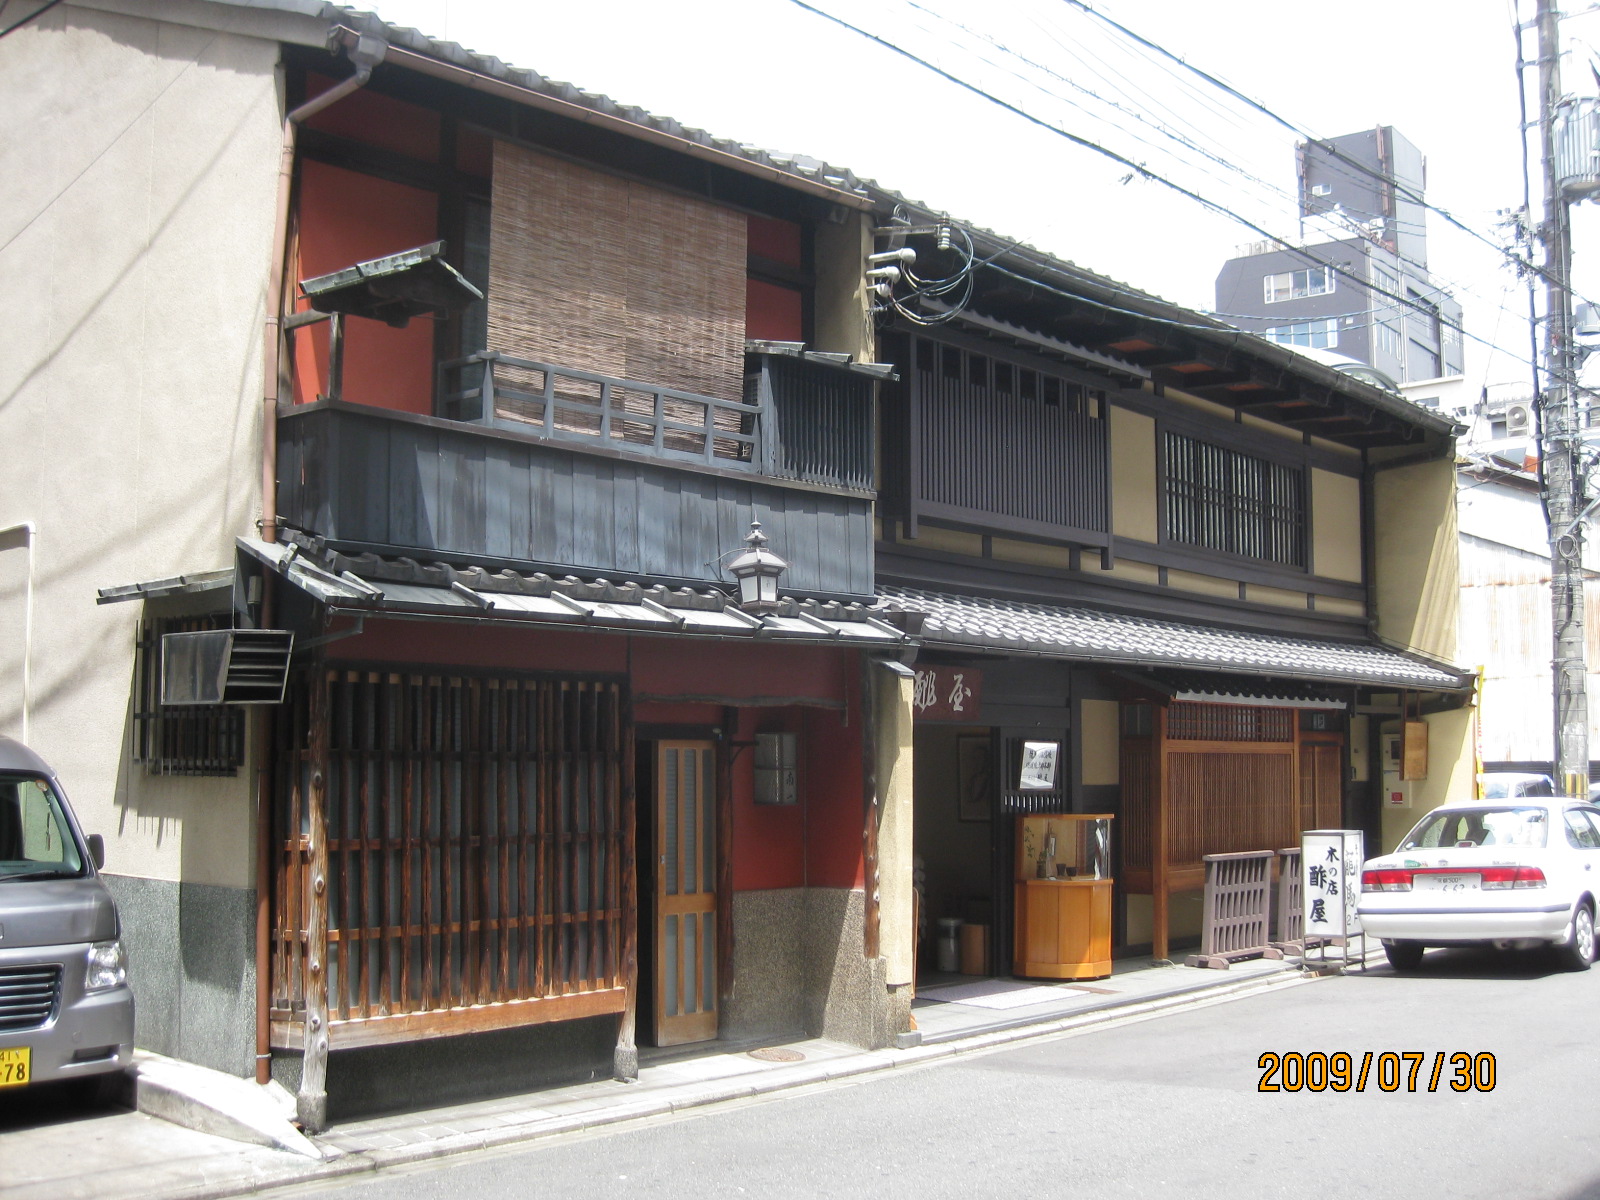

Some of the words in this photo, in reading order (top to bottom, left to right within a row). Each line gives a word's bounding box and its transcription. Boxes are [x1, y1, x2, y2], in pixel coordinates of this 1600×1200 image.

[1309, 864, 1328, 924] 酢屋
[1326, 846, 1340, 896] 木の店
